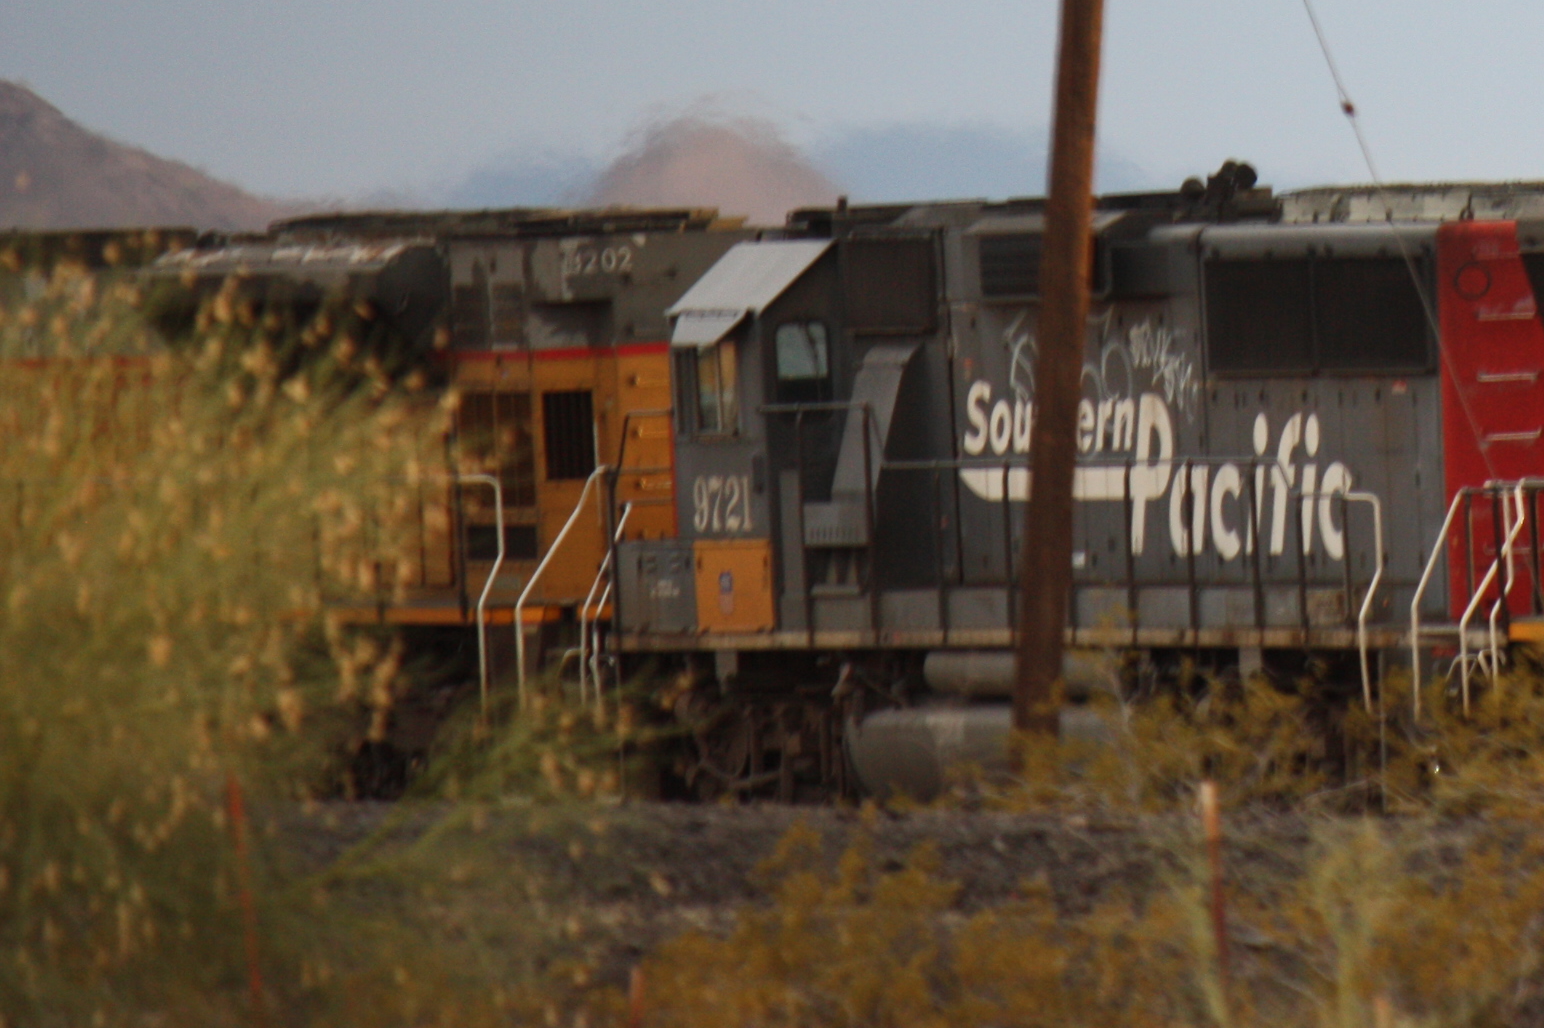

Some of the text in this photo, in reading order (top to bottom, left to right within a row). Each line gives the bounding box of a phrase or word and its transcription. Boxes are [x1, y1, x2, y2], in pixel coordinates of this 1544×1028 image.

[963, 379, 1136, 456] Souern
[693, 475, 752, 533] 9721
[1129, 392, 1353, 562] Pacific
